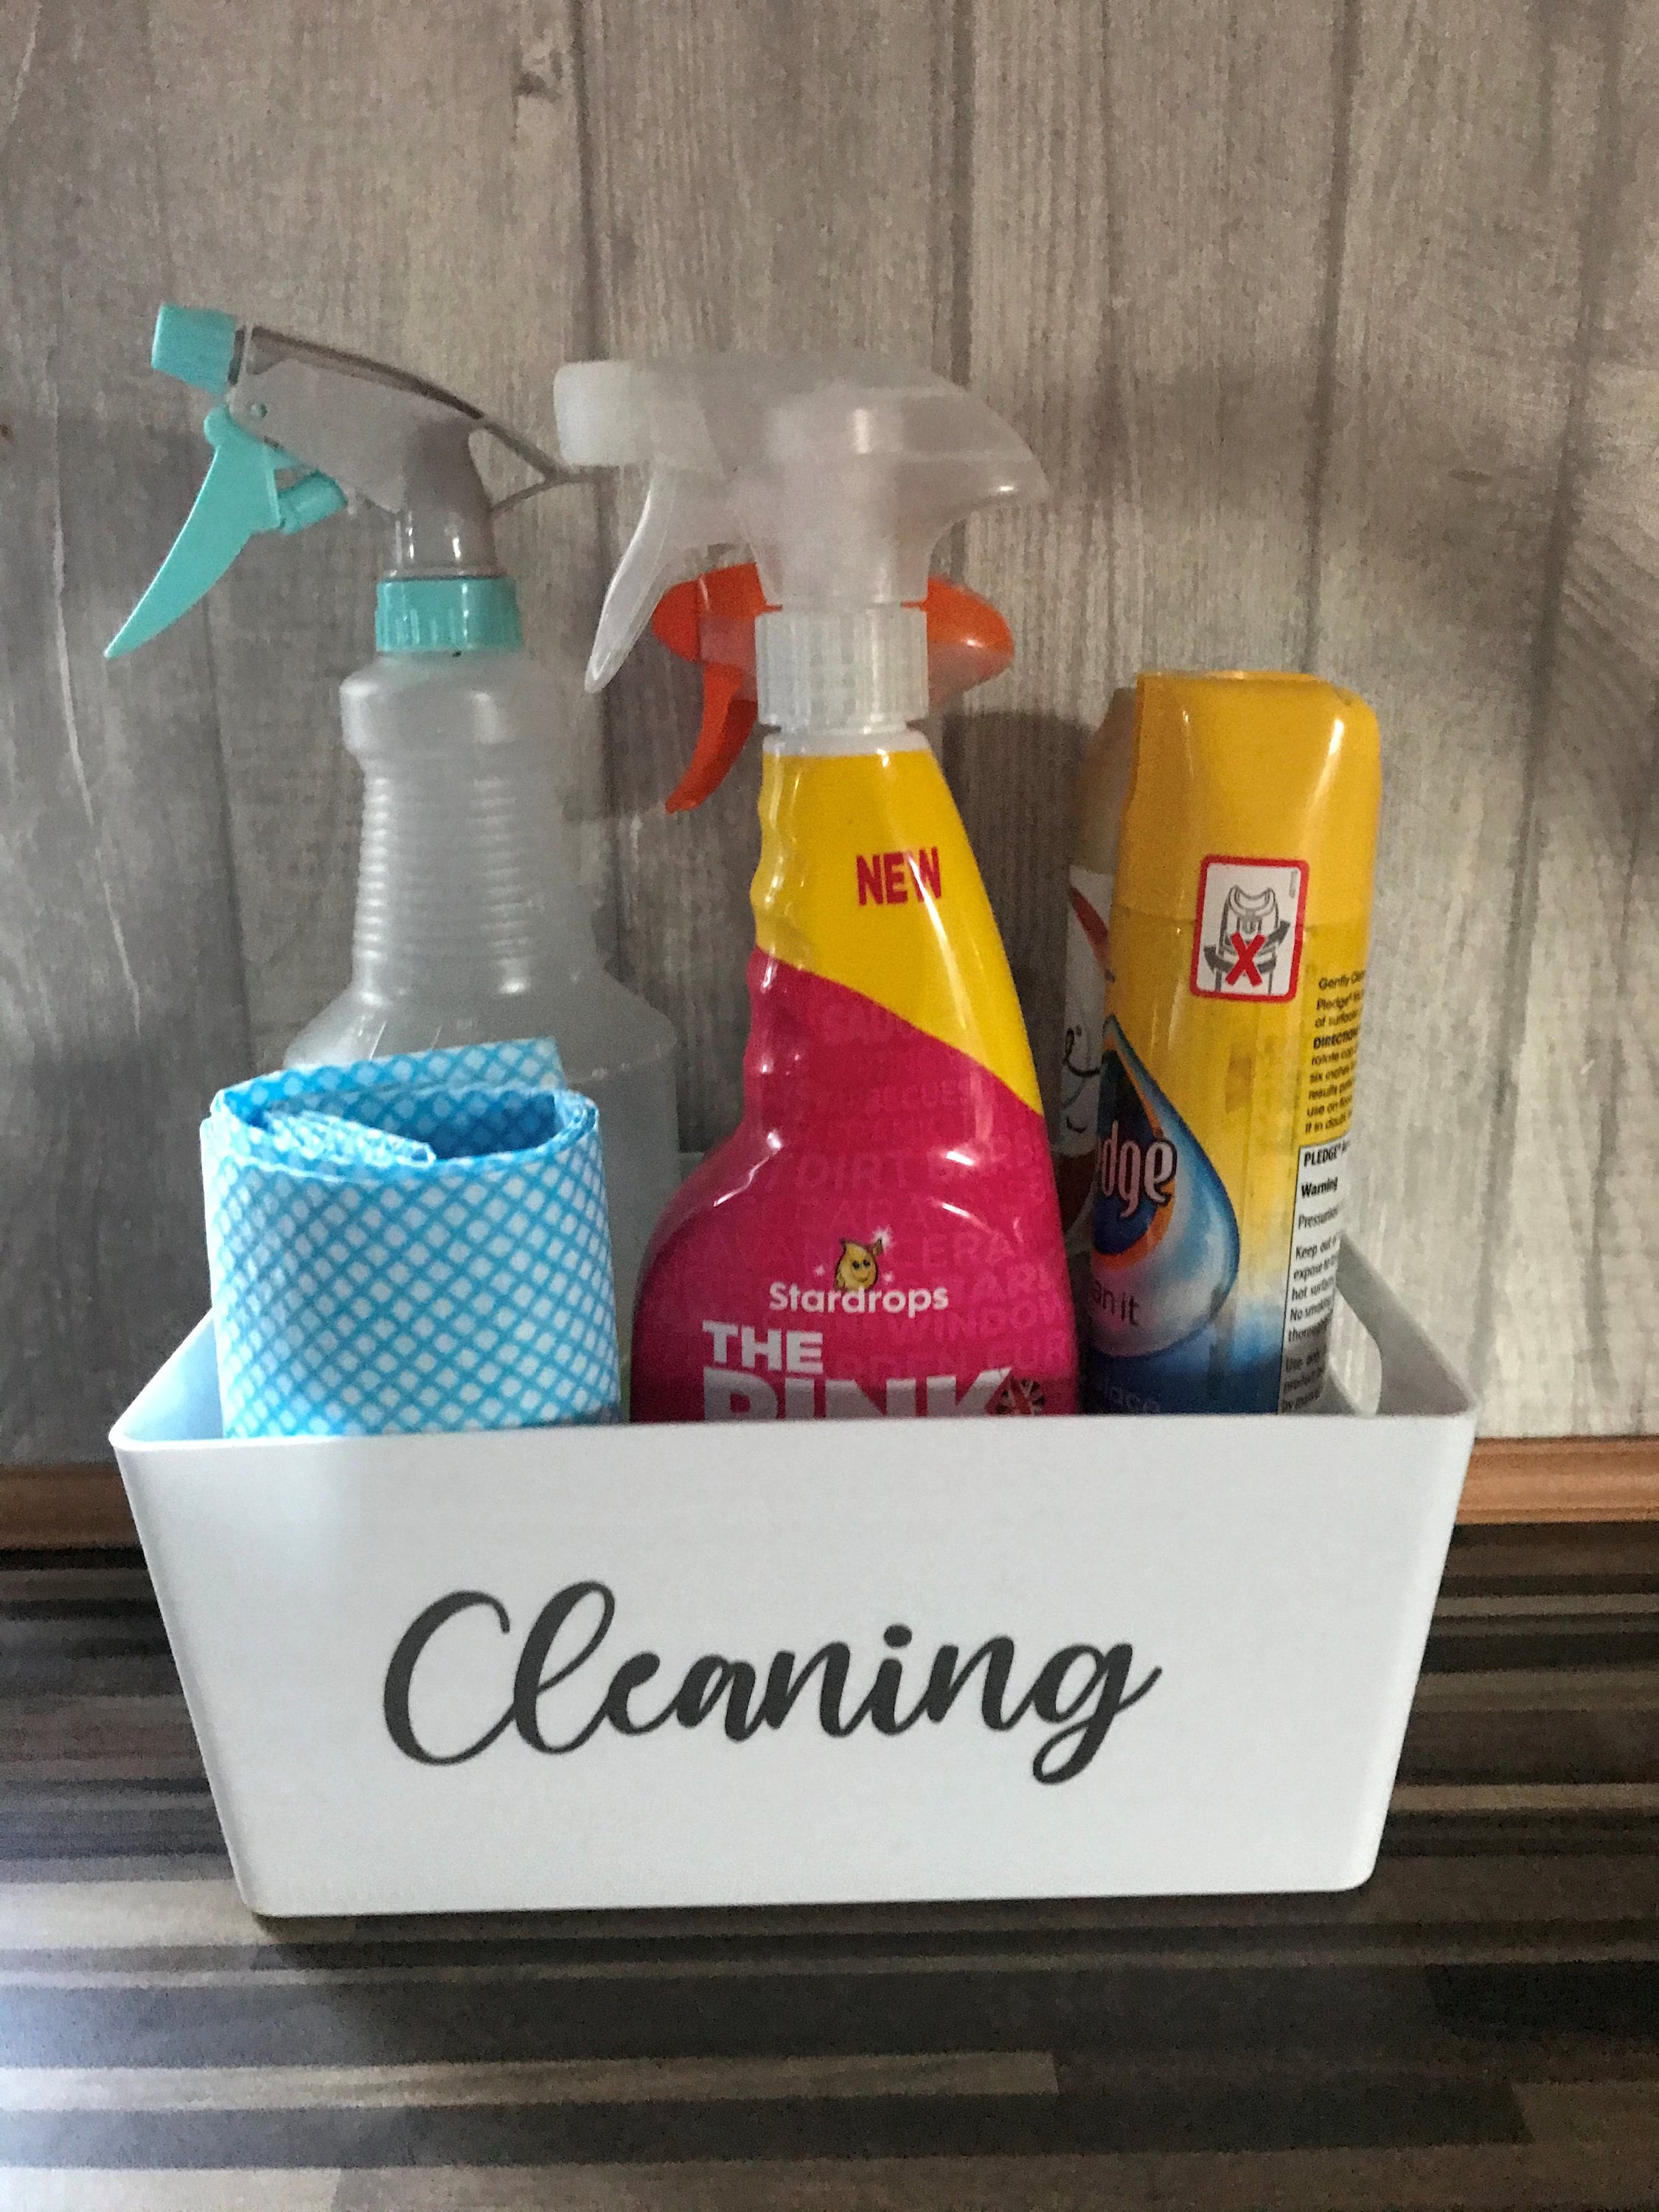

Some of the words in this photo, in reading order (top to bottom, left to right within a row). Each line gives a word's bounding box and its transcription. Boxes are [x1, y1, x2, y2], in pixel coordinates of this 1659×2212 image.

[856, 846, 942, 905] NEW
[769, 1281, 949, 1318] Stardrops
[702, 1319, 824, 1374] THE
[383, 1581, 1163, 1785] Cleaning
